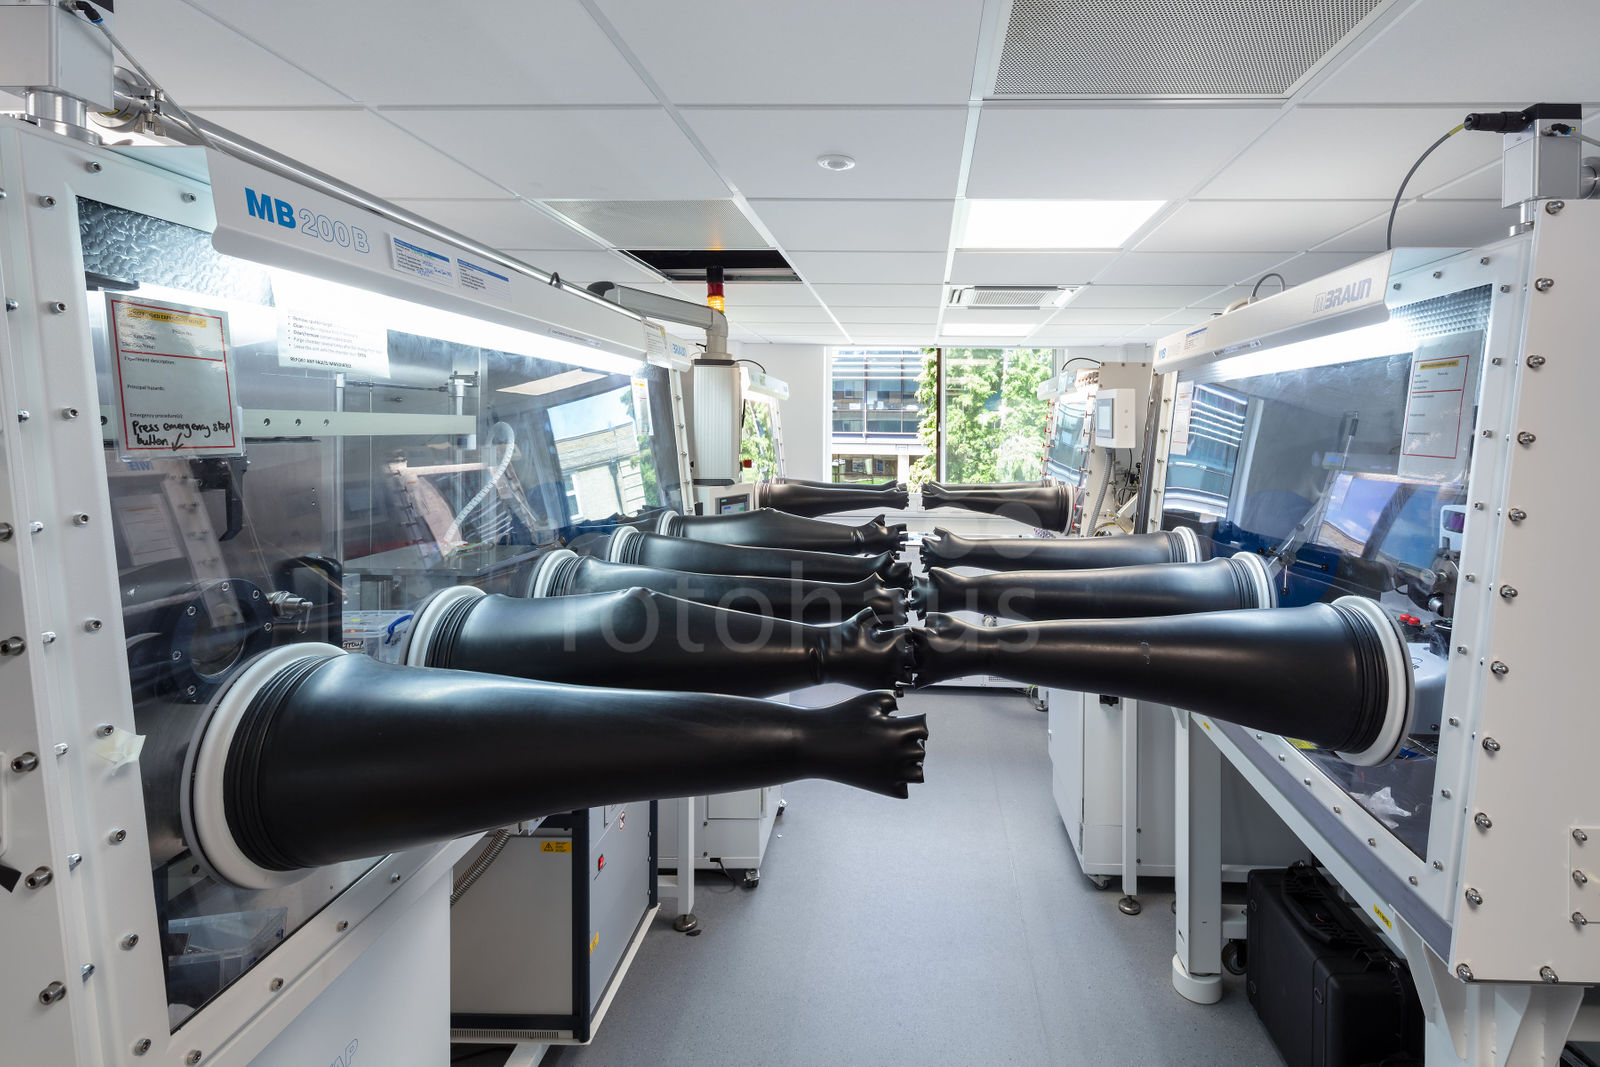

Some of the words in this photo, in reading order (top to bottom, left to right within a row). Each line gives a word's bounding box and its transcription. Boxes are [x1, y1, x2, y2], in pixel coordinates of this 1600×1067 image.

[245, 187, 296, 229] MB
[299, 208, 370, 254] 200B
[132, 420, 160, 436] Press
[163, 422, 211, 439] emergency
[213, 421, 231, 433] stop
[136, 433, 169, 446] button
